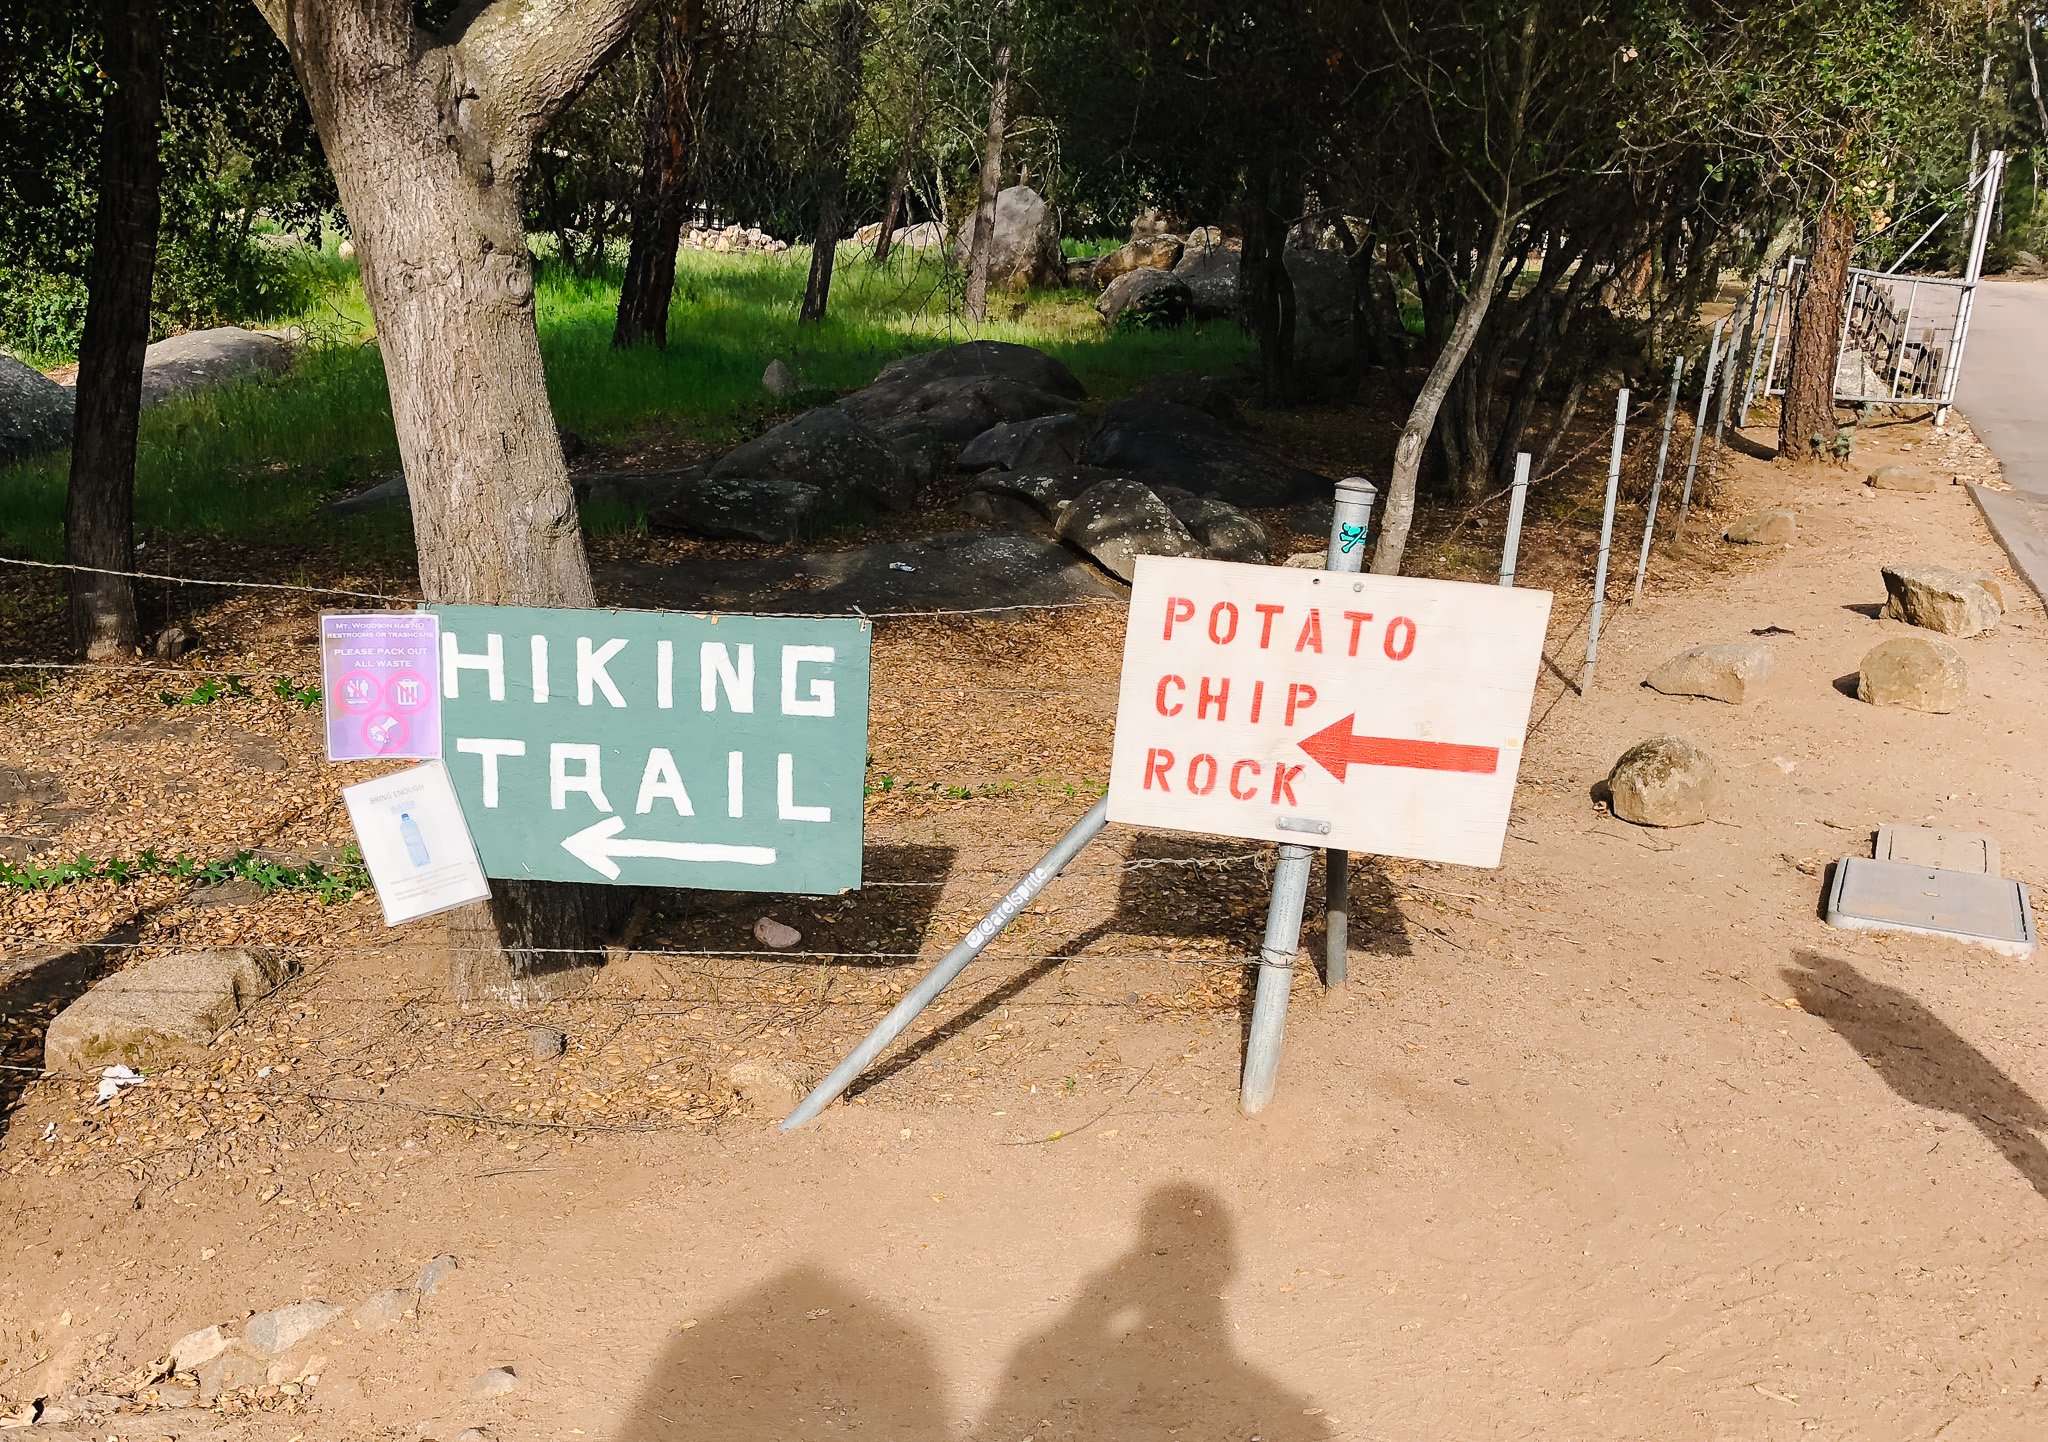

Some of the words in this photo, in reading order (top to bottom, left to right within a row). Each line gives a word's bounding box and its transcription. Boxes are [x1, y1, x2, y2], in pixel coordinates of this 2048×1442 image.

[334, 648, 375, 657] PLEASE
[377, 648, 405, 656] PACK
[407, 647, 429, 655] OUT
[352, 622, 393, 630] WOODSON
[411, 622, 425, 630] NO
[1162, 597, 1418, 662] POTATO
[354, 660, 374, 668] ALL
[376, 660, 412, 668] WASTE
[441, 632, 836, 717] HIKING
[1155, 674, 1318, 727] CHIP
[369, 792, 393, 805] BRING
[393, 783, 425, 798] ENOUGH
[456, 738, 832, 823] TRAIL
[1143, 748, 1307, 807] ROCK
